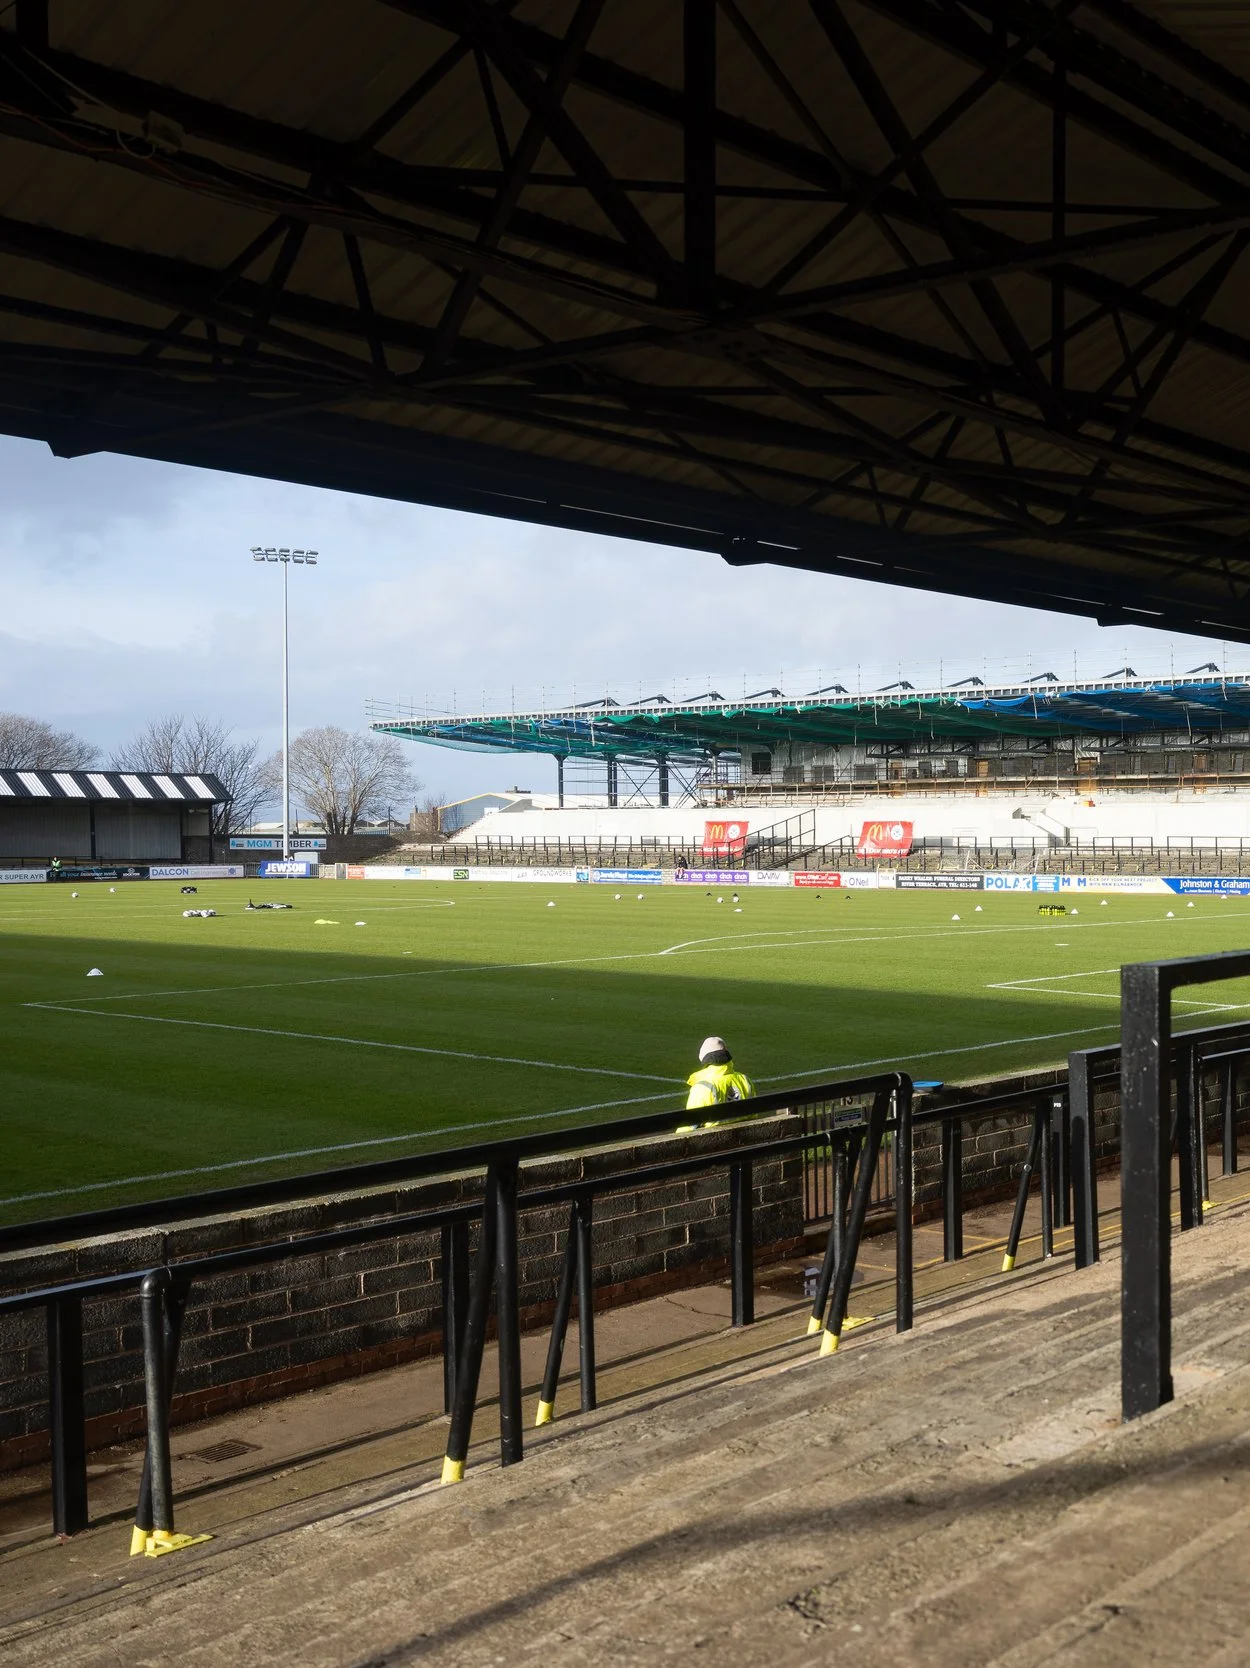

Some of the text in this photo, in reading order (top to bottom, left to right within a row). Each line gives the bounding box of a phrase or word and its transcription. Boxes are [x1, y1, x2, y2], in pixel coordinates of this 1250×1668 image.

[247, 840, 272, 848] MGM
[265, 862, 306, 872] JEWSON
[152, 868, 189, 876] DALCON
[1180, 880, 1212, 889] Johnston
[1221, 880, 1250, 889] Graham
